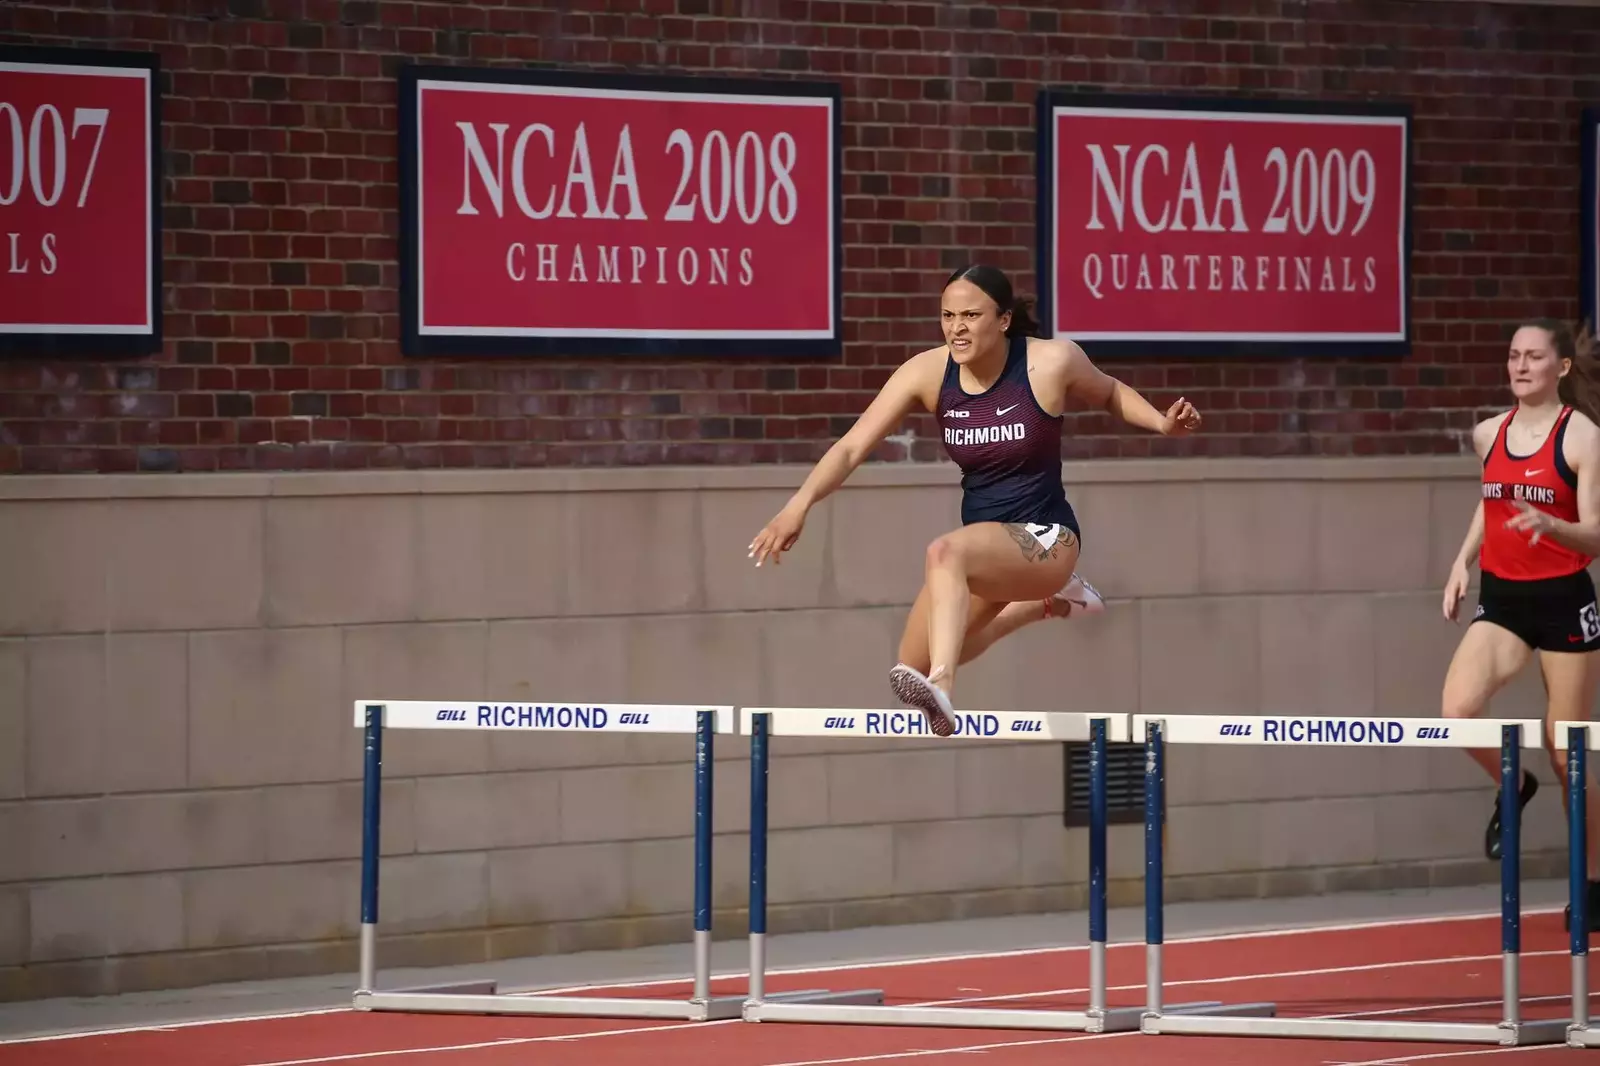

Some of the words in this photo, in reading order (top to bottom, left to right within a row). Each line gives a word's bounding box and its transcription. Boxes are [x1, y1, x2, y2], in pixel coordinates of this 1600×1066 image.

[456, 121, 647, 221] NCAA
[664, 128, 797, 226] 2008
[1086, 143, 1248, 233] NCAA
[1264, 147, 1376, 237] 2009
[506, 242, 754, 287] CHAMPIONS
[1083, 253, 1376, 299] QUARTERFINALS
[944, 422, 1025, 446] RICHMOND
[436, 709, 466, 721] GILL
[477, 705, 608, 729] RICHMOND
[619, 713, 649, 725] GILL
[824, 717, 855, 729] GILL
[866, 712, 999, 736] RICHOND
[1011, 720, 1042, 732] GILL
[1219, 724, 1252, 736] GILL
[1263, 719, 1404, 744] RICHMOND
[1416, 727, 1450, 739] GILL
